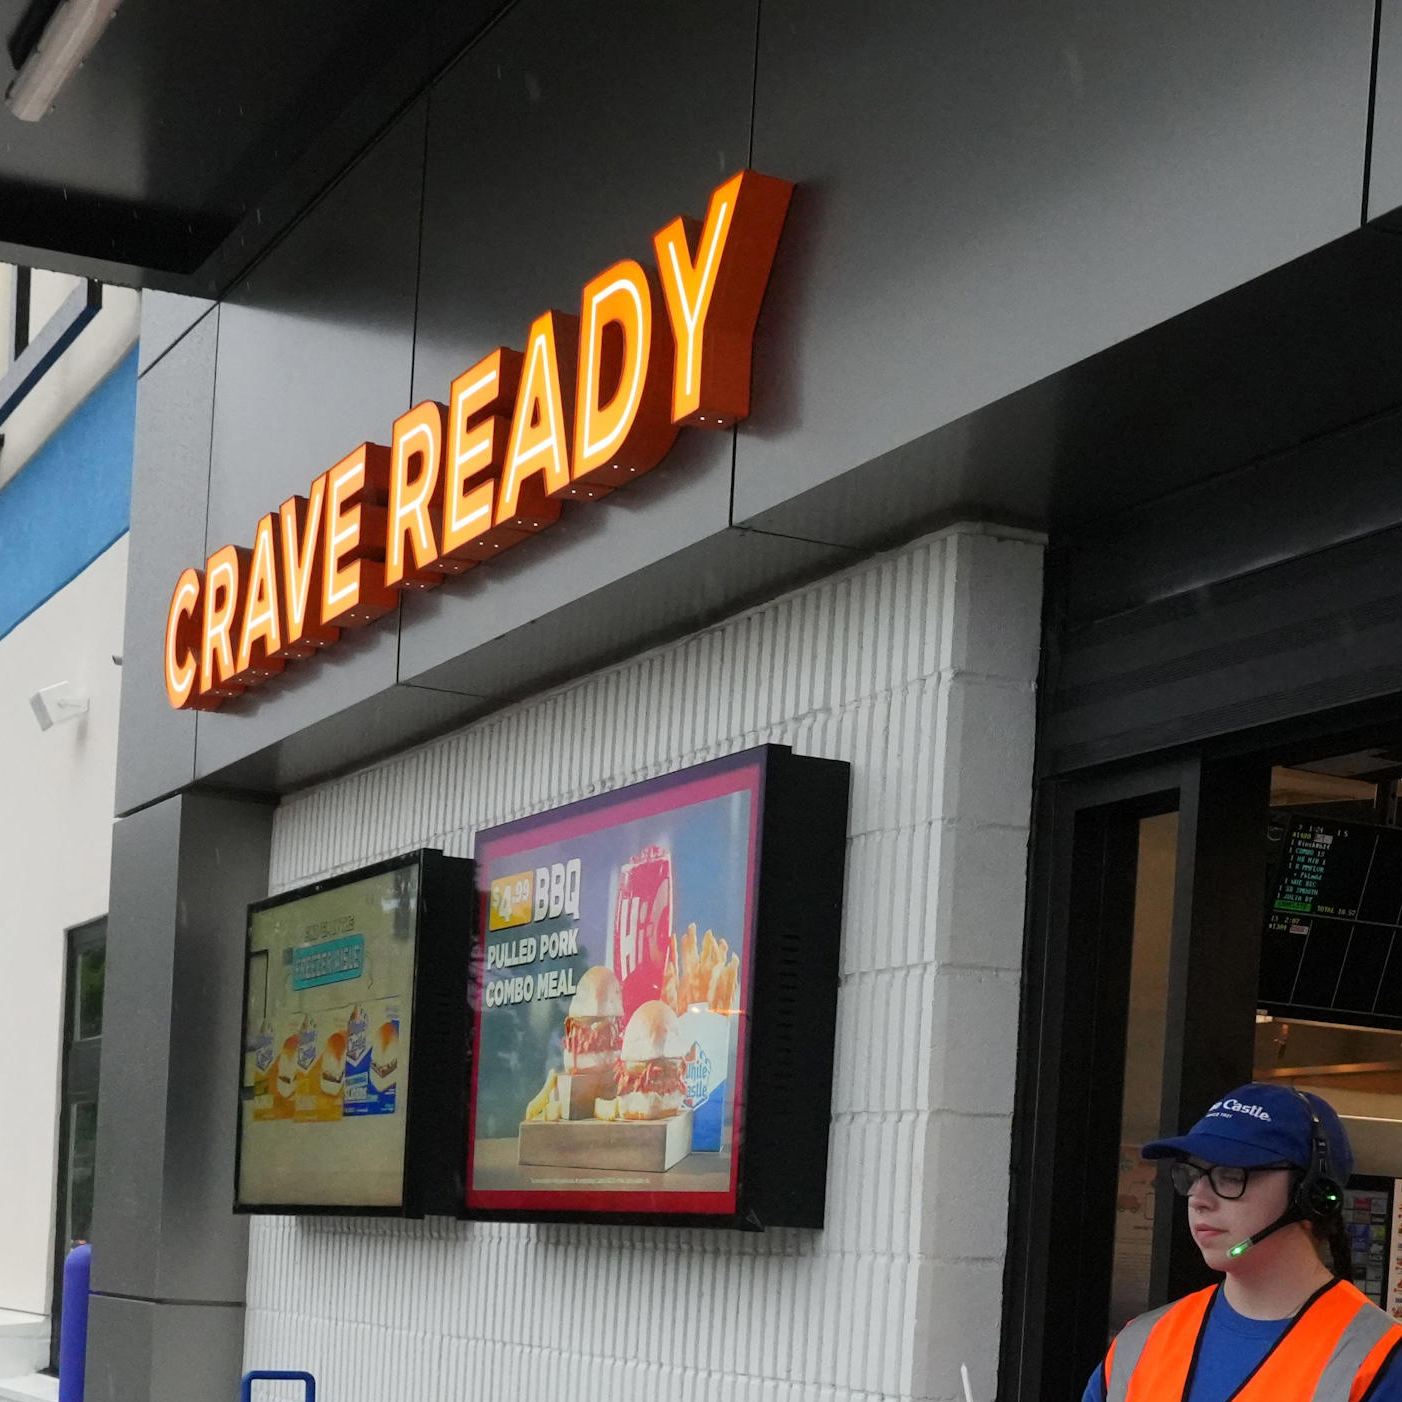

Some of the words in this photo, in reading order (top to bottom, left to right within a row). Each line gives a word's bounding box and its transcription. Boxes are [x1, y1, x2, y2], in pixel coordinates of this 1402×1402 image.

[164, 442, 376, 710] CRAVE
[385, 170, 768, 589] READY
[533, 858, 582, 922] BBQ
[487, 937, 537, 971] PULLED
[540, 928, 578, 961] PORK
[486, 975, 534, 1008] COMBO
[537, 968, 577, 1001] MEAL
[1223, 1098, 1271, 1121] Castle
